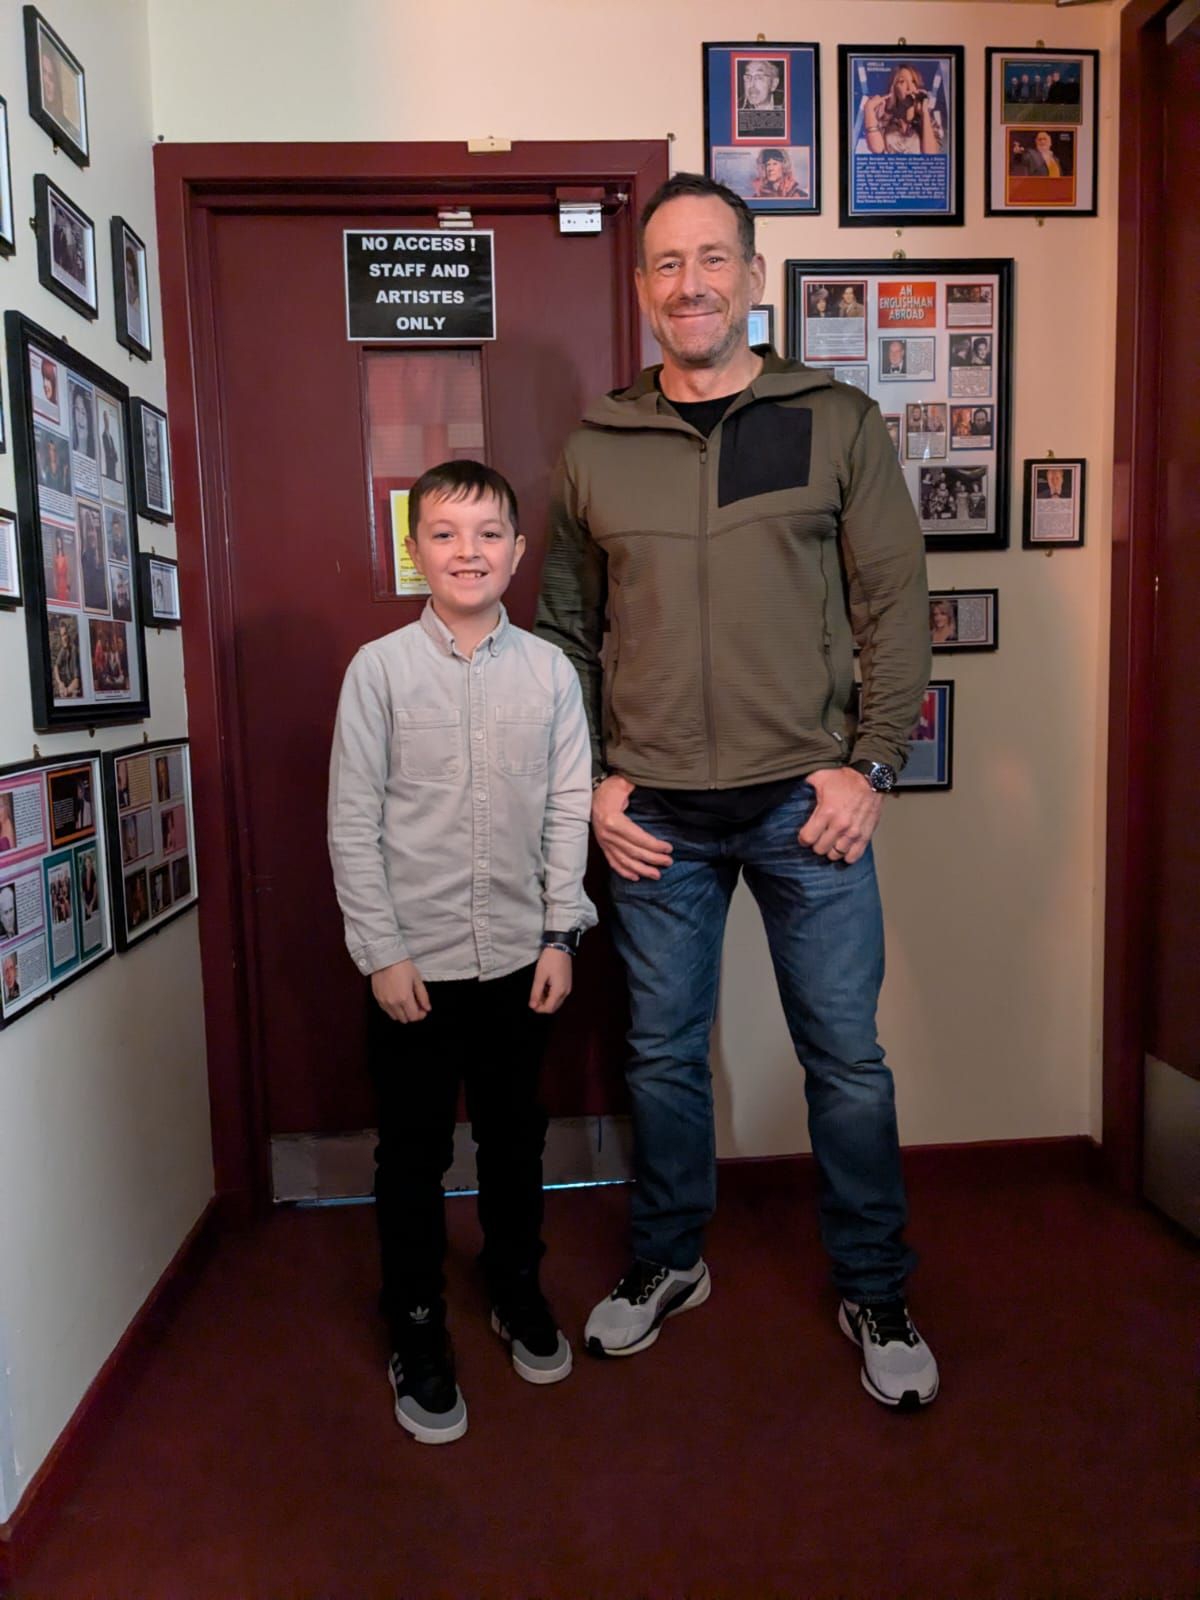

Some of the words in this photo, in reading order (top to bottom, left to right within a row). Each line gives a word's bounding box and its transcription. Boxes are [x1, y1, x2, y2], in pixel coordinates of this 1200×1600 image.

[361, 237, 388, 251] NO
[393, 237, 465, 252] ACCESS
[470, 238, 476, 252] !
[369, 263, 426, 278] STAFF
[431, 264, 470, 278] AND
[375, 290, 465, 304] ARTISTES
[899, 284, 913, 297] AN
[879, 296, 934, 309] ENGLISHMAN
[888, 308, 925, 321] ABROAD
[396, 316, 446, 330] ONLY
